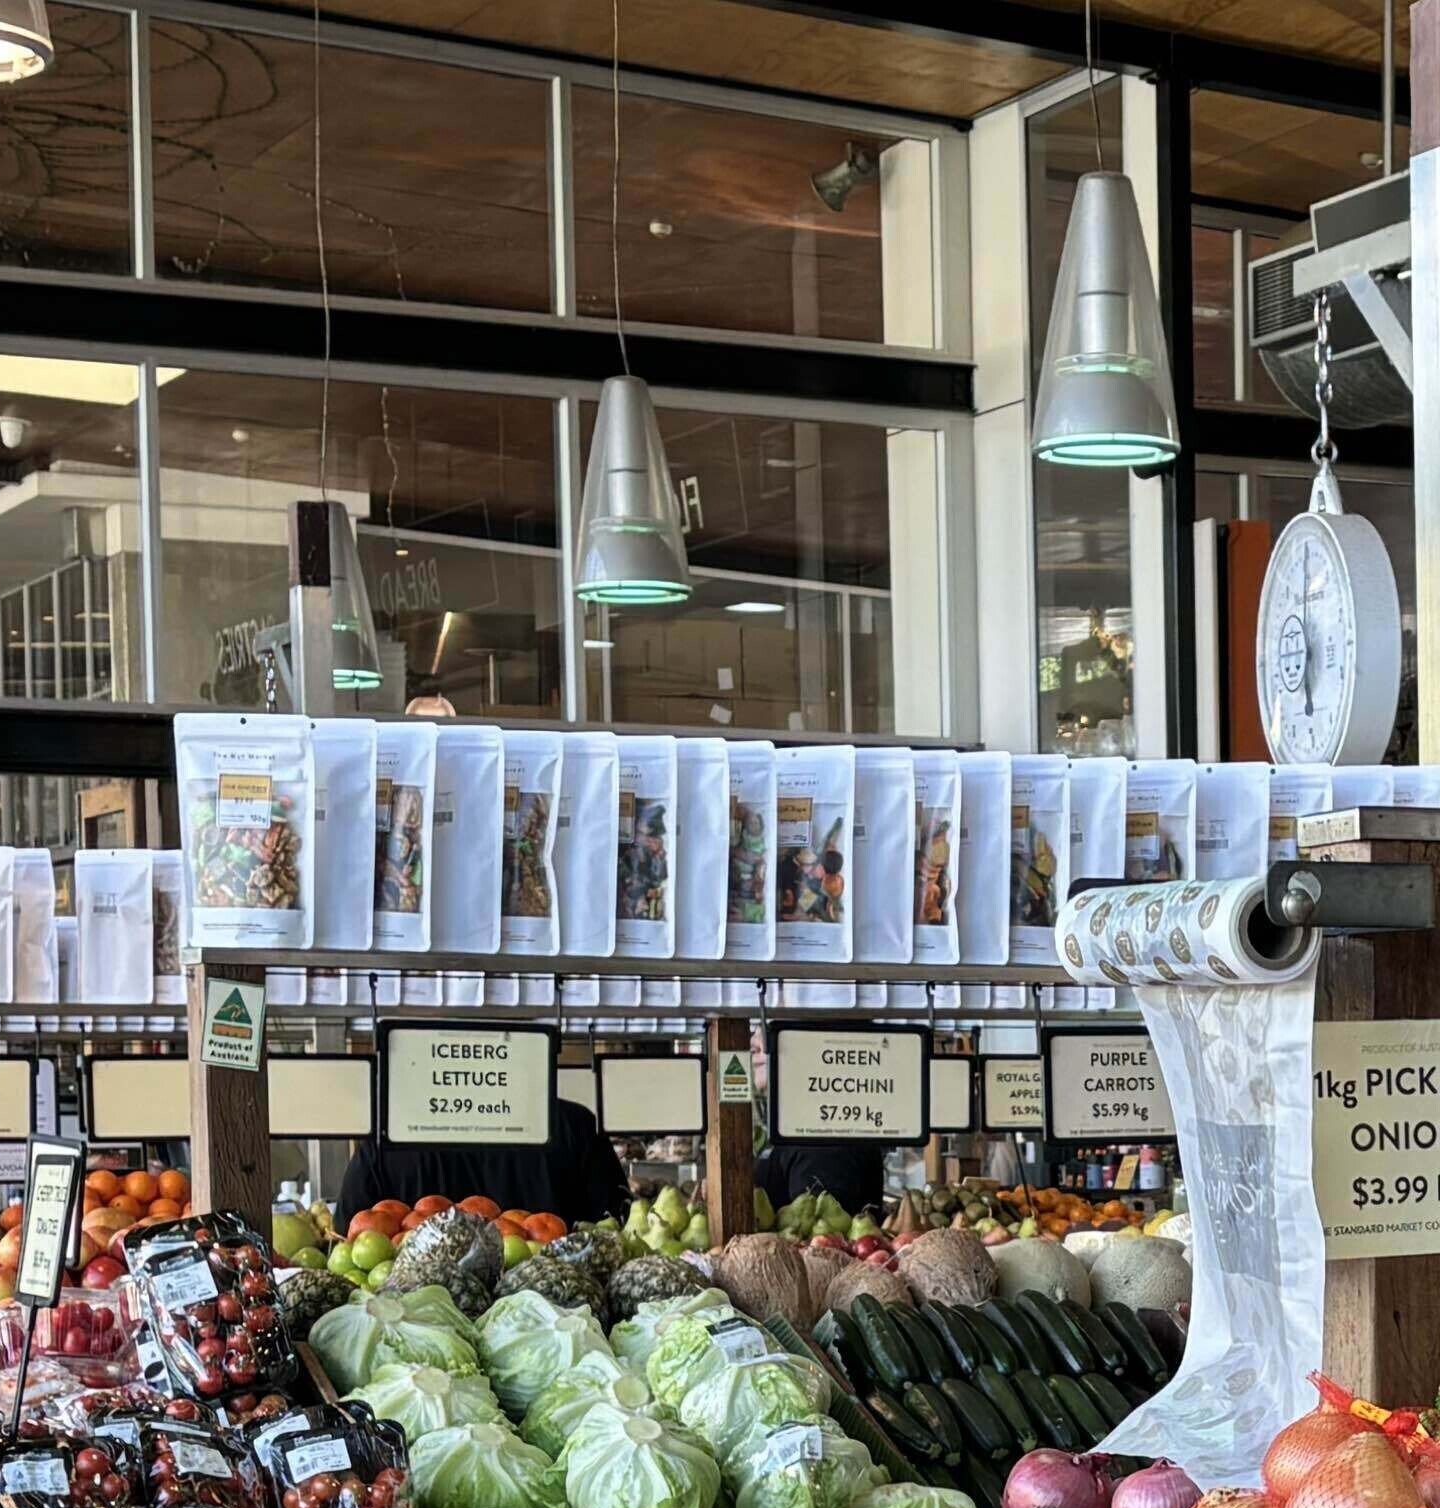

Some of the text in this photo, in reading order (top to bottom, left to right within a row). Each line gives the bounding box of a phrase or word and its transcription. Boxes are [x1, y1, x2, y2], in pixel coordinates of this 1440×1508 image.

[208, 1039, 241, 1050] Product
[431, 1043, 508, 1060] ICEBERG
[822, 1049, 881, 1066] GREEN
[1091, 1052, 1147, 1067] PURPLE
[432, 1071, 508, 1086] LETTUCE
[808, 1077, 894, 1094] ZUCCHINI
[996, 1073, 1030, 1083] ROYAL
[1084, 1078, 1155, 1092] CARROTS
[1313, 1071, 1358, 1109] 1kg
[429, 1098, 511, 1114] $2.99 each
[1092, 1103, 1149, 1120] $5.99 kg
[819, 1104, 883, 1127] $7.99 kg
[1352, 1176, 1428, 1210] $3.99
